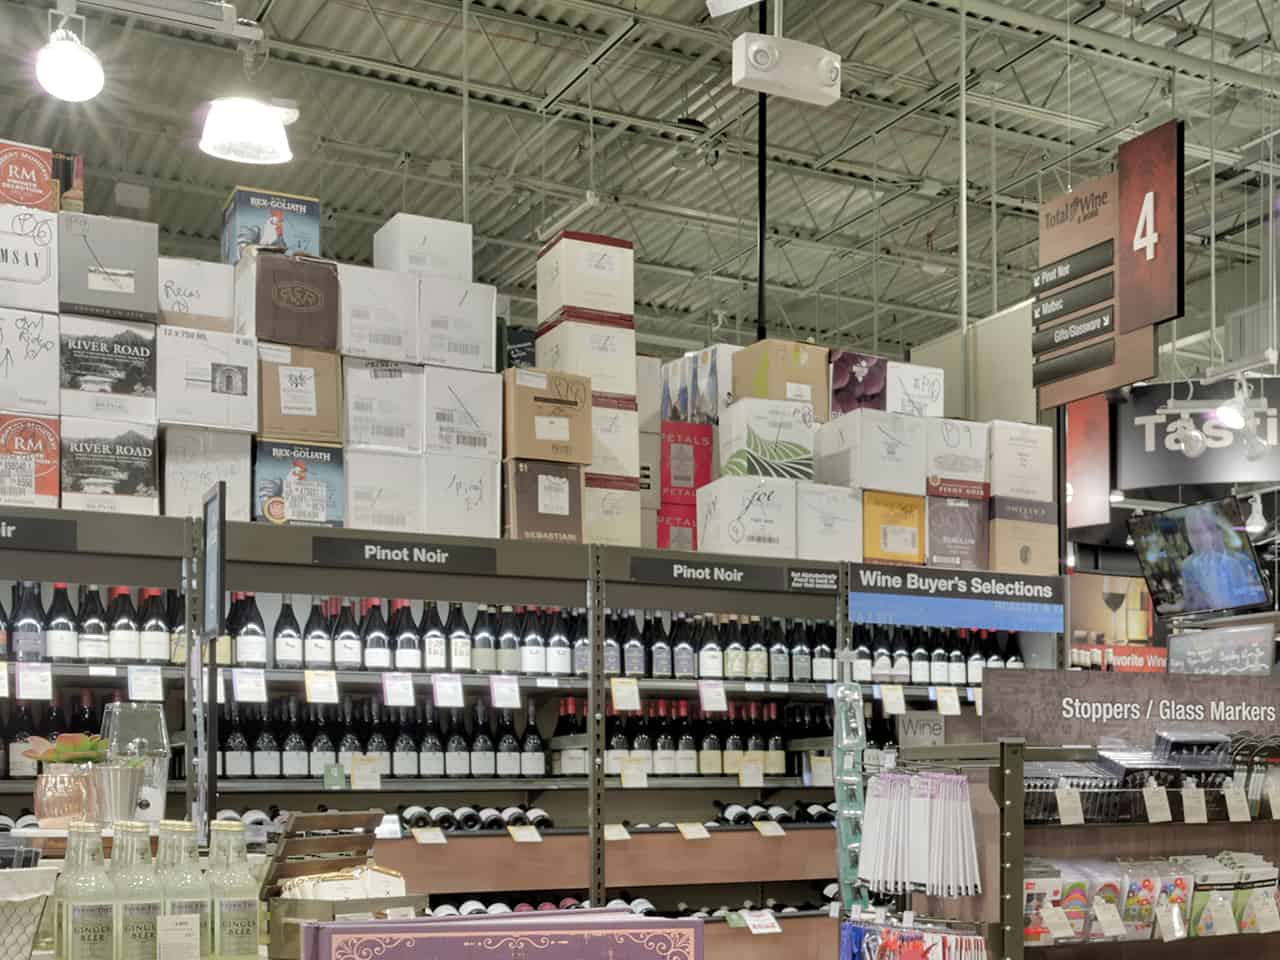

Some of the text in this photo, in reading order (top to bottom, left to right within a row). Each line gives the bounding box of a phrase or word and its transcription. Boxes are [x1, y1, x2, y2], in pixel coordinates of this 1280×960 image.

[8, 165, 36, 182] RM
[1132, 190, 1160, 262] 4
[68, 338, 150, 358] RIVER ROAD
[14, 437, 43, 451] RM
[69, 442, 153, 457] RIVER ROAD
[364, 545, 449, 564] Pinot Noir
[673, 564, 744, 582] Pinot Noir
[859, 569, 903, 589] Wine
[907, 573, 967, 595] Buyer's
[970, 577, 1053, 598] Selections
[1061, 697, 1277, 722] Stoppers / Glass Markers
[903, 718, 942, 736] Wine
